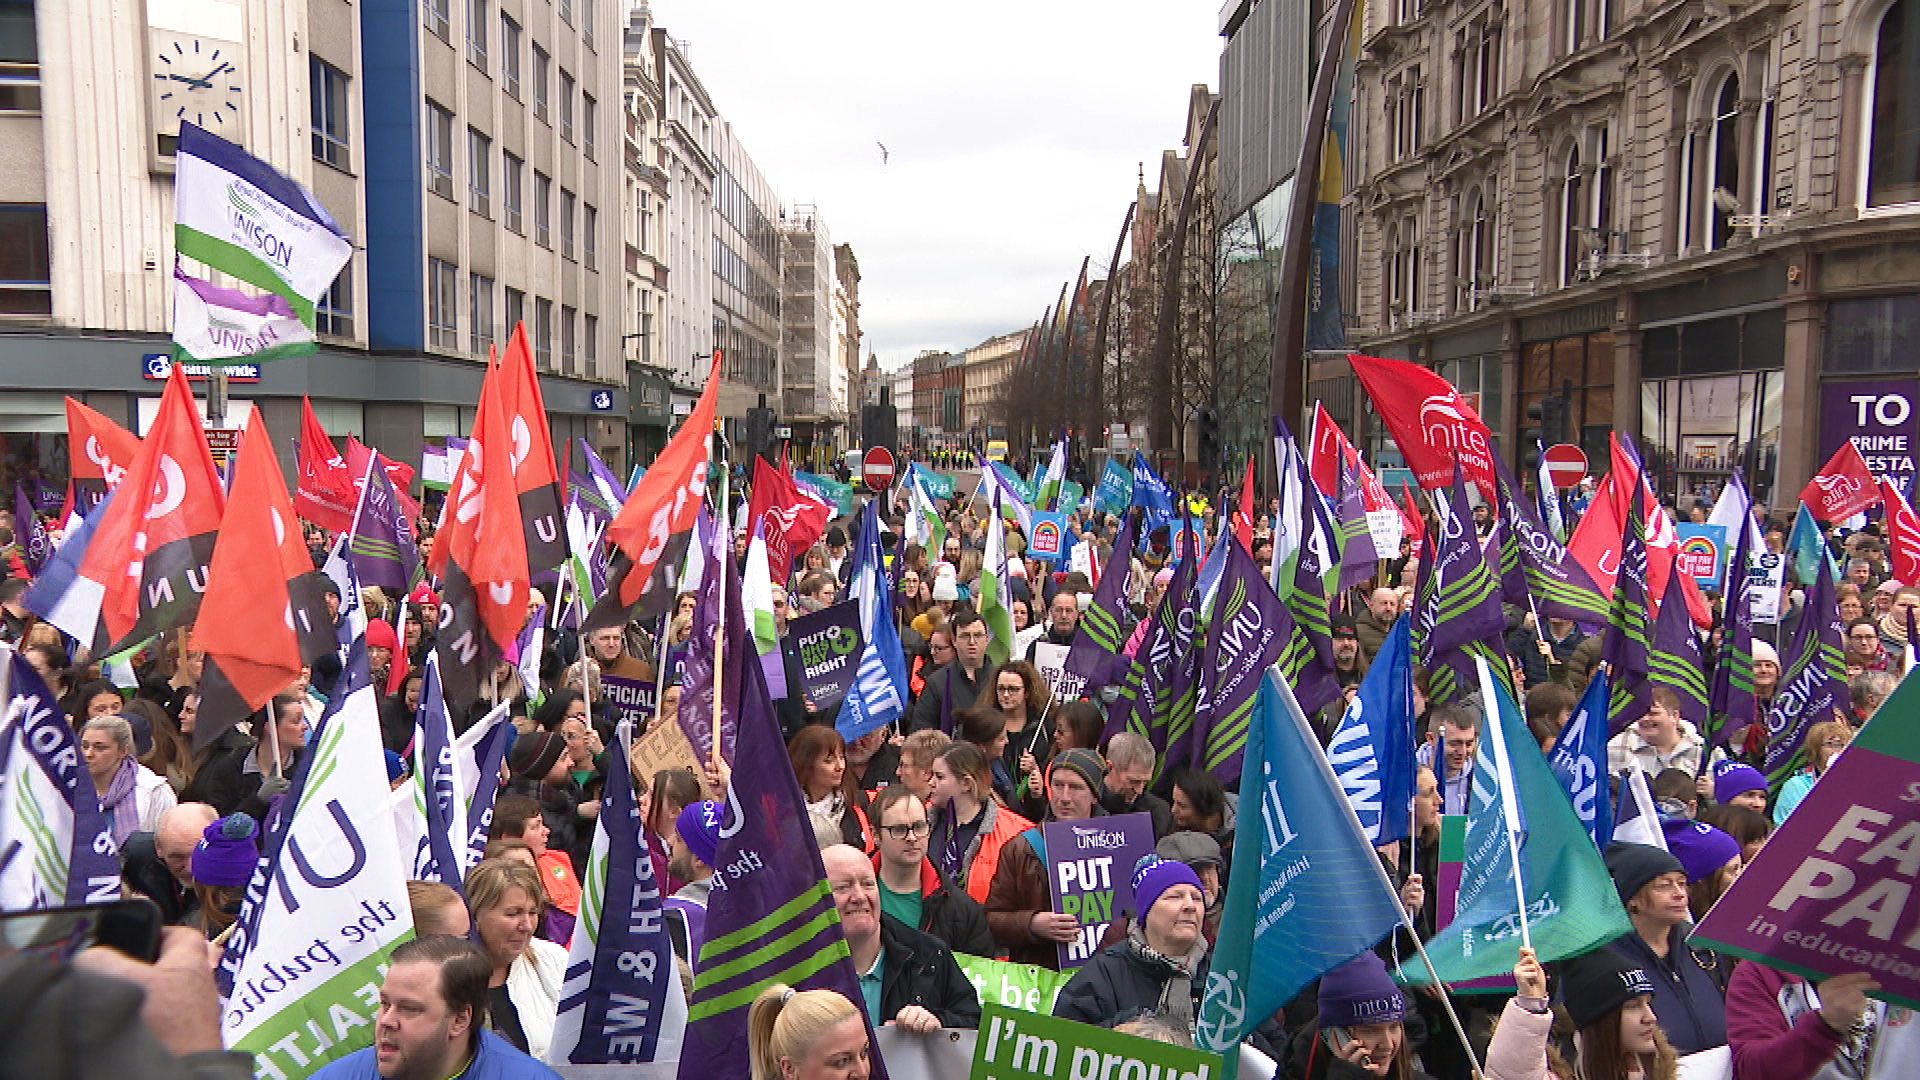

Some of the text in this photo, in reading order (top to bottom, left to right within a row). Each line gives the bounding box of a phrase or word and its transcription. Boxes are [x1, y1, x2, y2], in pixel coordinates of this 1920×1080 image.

[227, 205, 293, 268] UNISON
[1851, 394, 1911, 427] TO
[1851, 436, 1908, 451] PRIME
[1458, 451, 1489, 471] NION
[1866, 456, 1915, 471] ESTA
[805, 656, 847, 679] RIGHT
[600, 683, 656, 708] FFICIAL
[1077, 832, 1126, 849] UNISON
[1816, 803, 1920, 877] FA
[1058, 856, 1113, 894] PUT
[1062, 890, 1115, 925] PAY
[1766, 856, 1920, 951] PA
[1068, 924, 1110, 961] RIG
[1747, 914, 1778, 939] in
[1001, 973, 1040, 1012] be
[984, 1015, 1210, 1080] I'm pro
